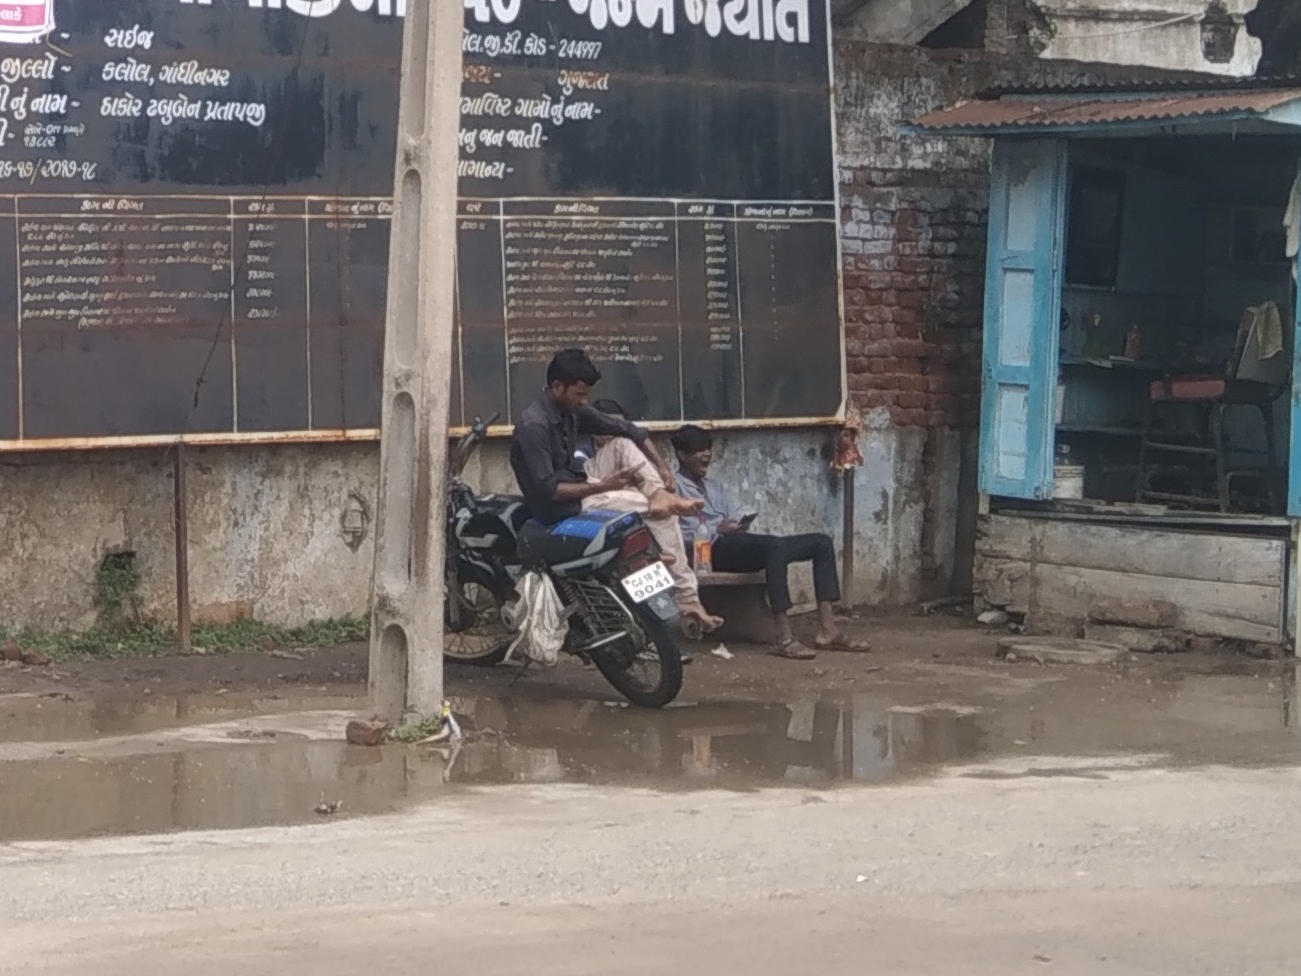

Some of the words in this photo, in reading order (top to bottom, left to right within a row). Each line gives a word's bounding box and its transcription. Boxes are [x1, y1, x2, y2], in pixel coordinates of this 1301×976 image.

[104, 24, 155, 49] સઈજ
[558, 39, 602, 59] 244997
[159, 60, 230, 87] ગાંધીનગર
[100, 91, 143, 117] ઠાકોર
[204, 100, 266, 127] પ્રતાપજી
[460, 92, 511, 116] માવિષ્ટ
[479, 129, 504, 147] જન
[634, 576, 670, 598] 9041
